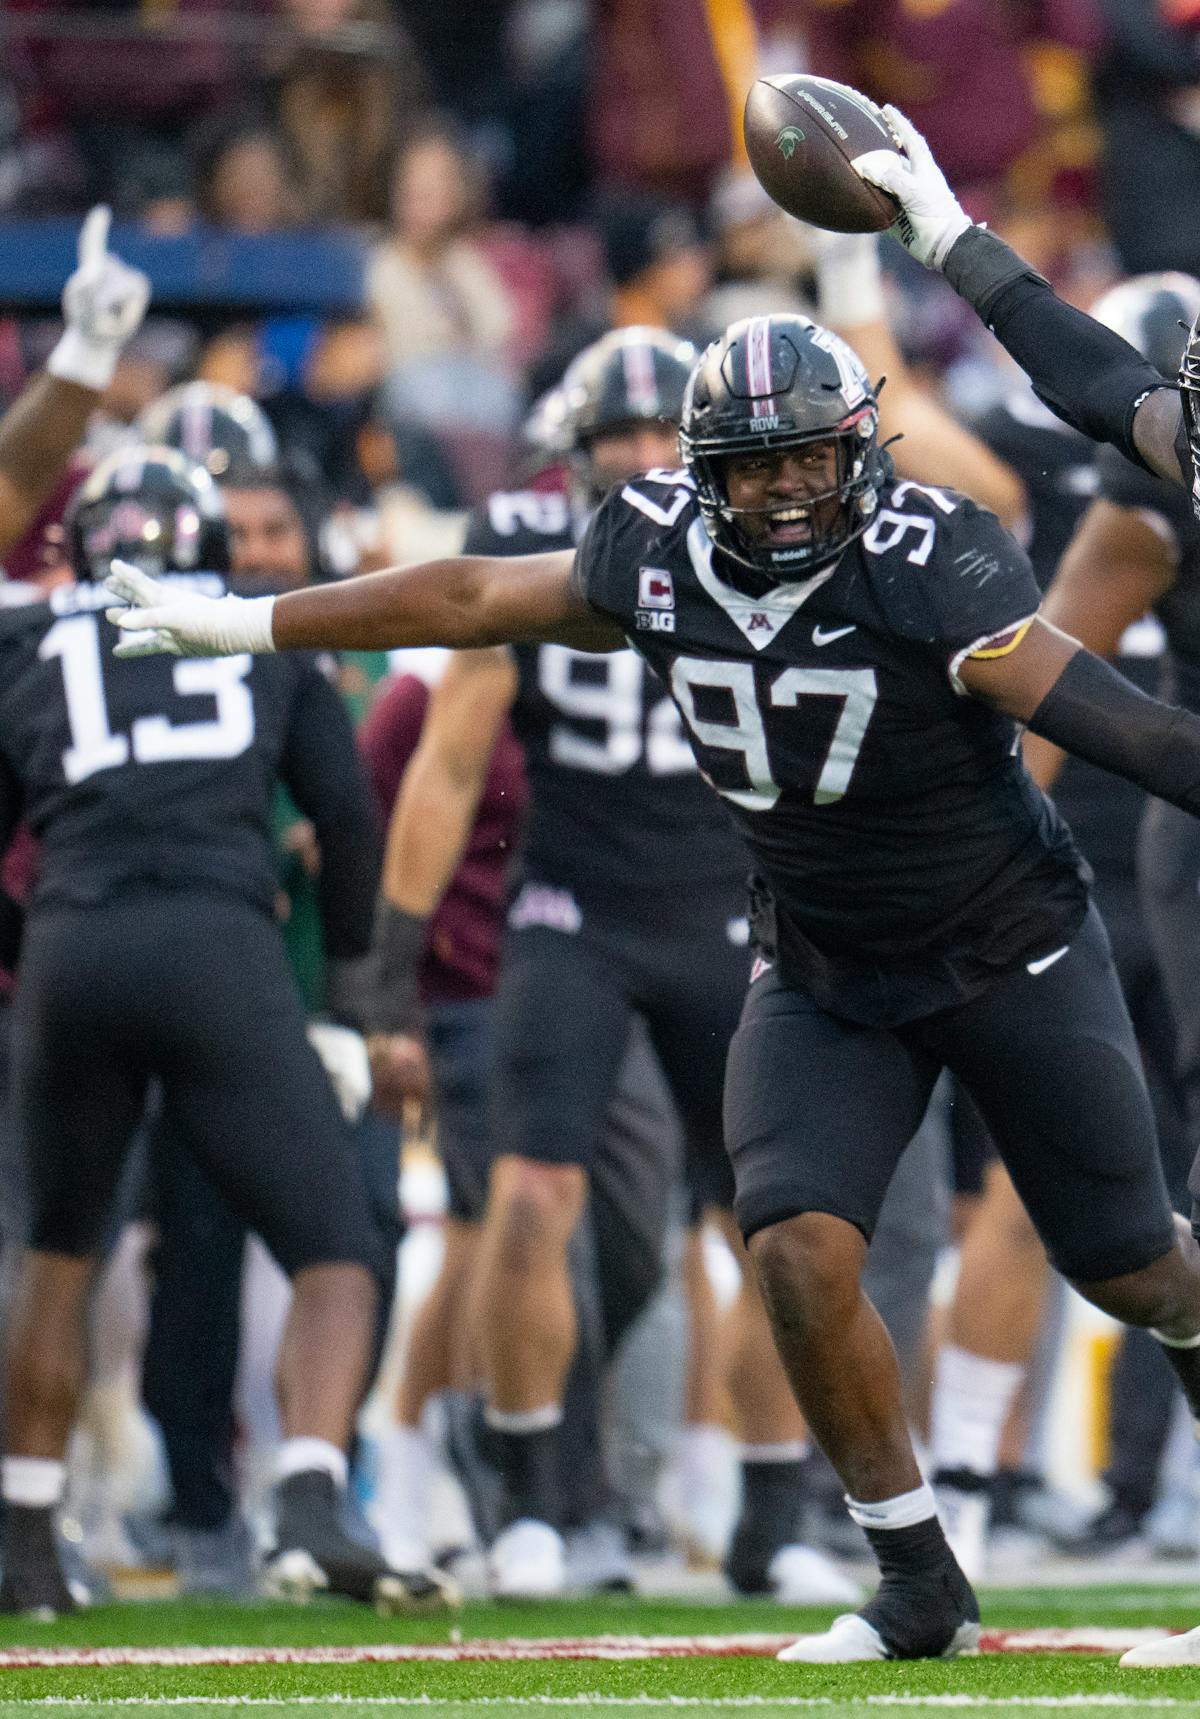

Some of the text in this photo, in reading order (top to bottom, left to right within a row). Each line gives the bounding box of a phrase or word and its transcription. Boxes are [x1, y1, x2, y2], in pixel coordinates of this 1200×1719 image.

[749, 416, 780, 432] ROW
[863, 481, 957, 567] 97
[38, 613, 256, 786] 13
[670, 655, 878, 812] 97
